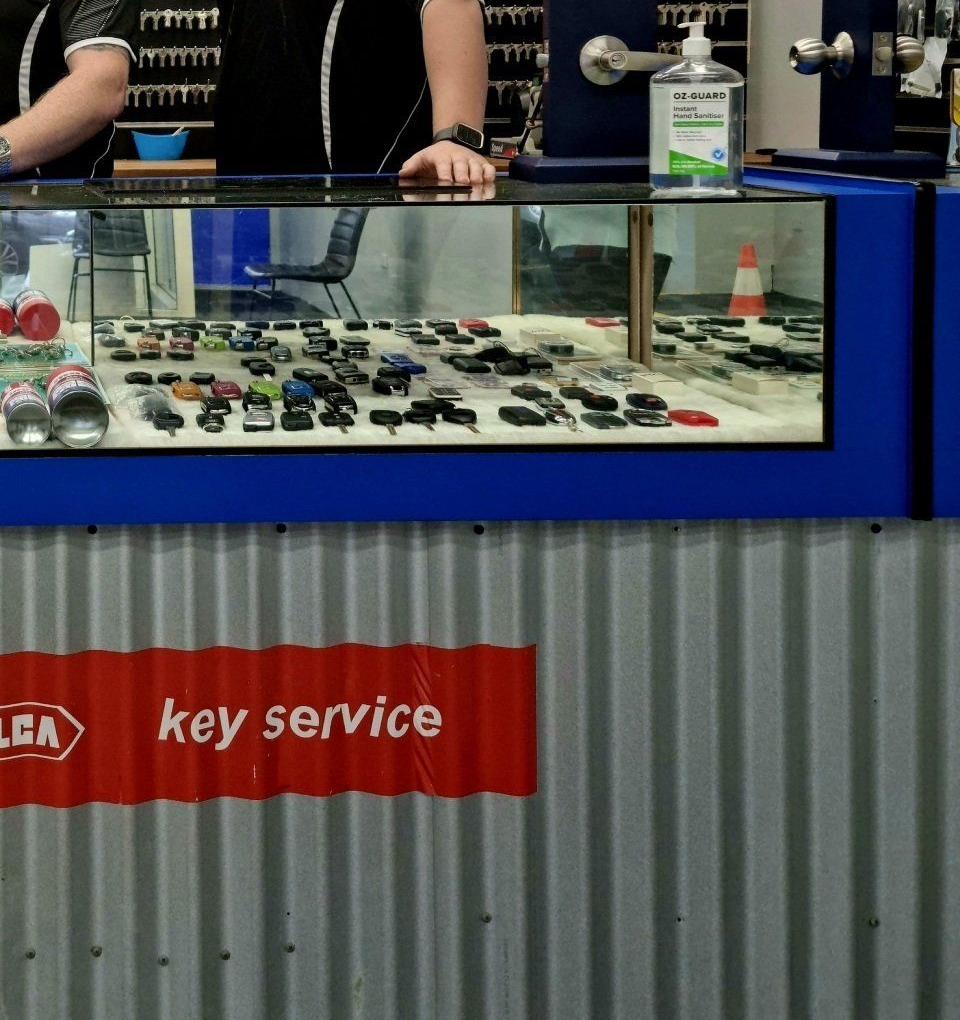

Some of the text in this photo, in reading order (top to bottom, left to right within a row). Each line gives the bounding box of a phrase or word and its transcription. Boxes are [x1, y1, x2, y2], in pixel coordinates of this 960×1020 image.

[673, 92, 727, 100] OZ-GUARD
[158, 697, 248, 751] key
[262, 694, 442, 740] service
